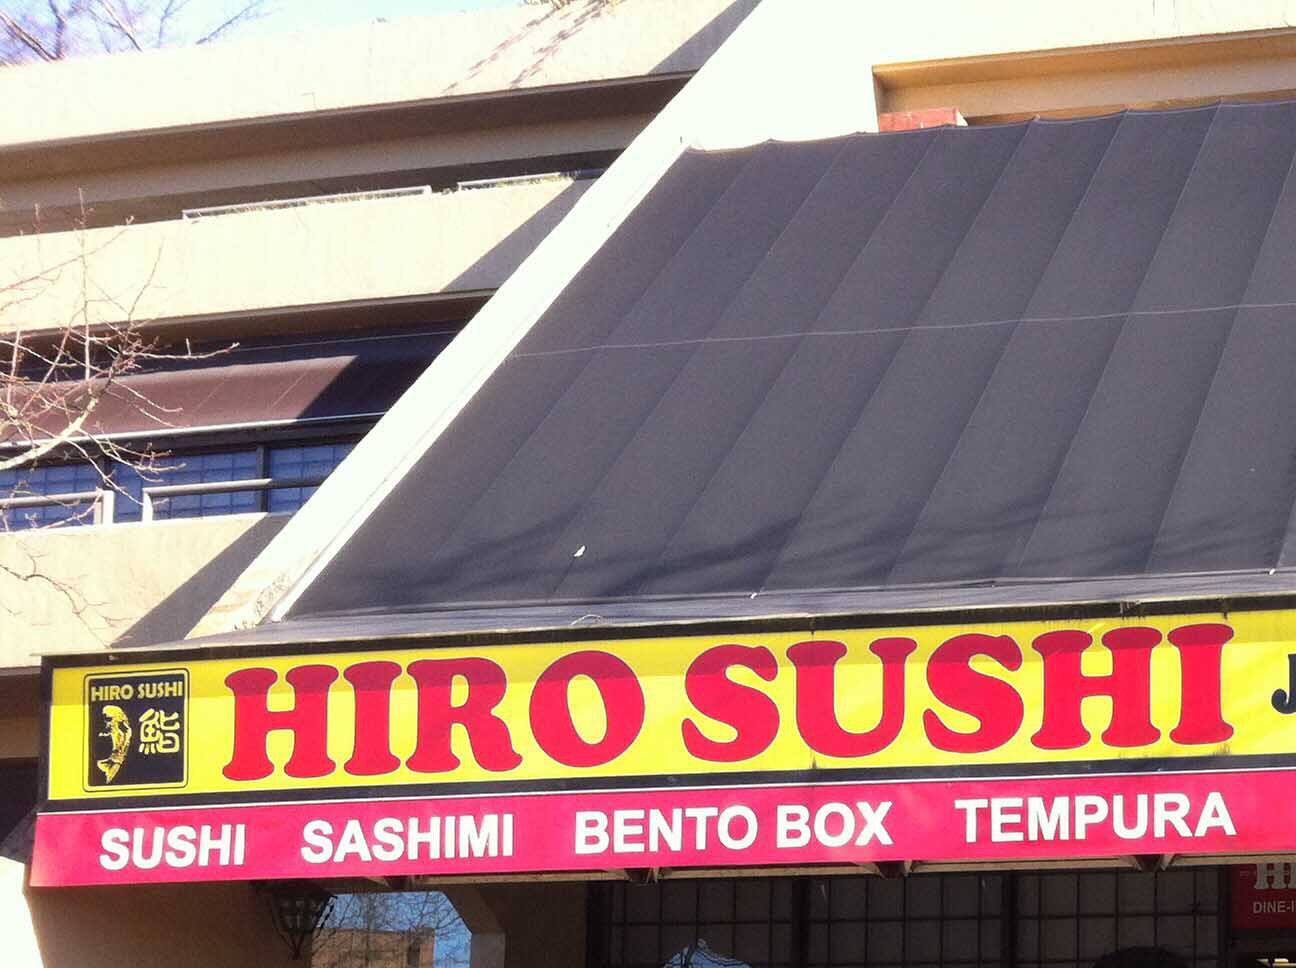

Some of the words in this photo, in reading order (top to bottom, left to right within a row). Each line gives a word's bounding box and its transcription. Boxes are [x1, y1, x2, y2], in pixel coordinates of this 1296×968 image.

[91, 684, 134, 702] HIRO
[137, 681, 183, 699] SUSHI
[222, 650, 646, 781] HIRO
[681, 623, 1235, 763] SUSHI
[98, 822, 246, 871] SUSHI
[300, 813, 514, 865] SASHIMI
[575, 806, 758, 855] BENTO
[775, 801, 895, 850] BOX
[955, 792, 1237, 843] TEMPURA
